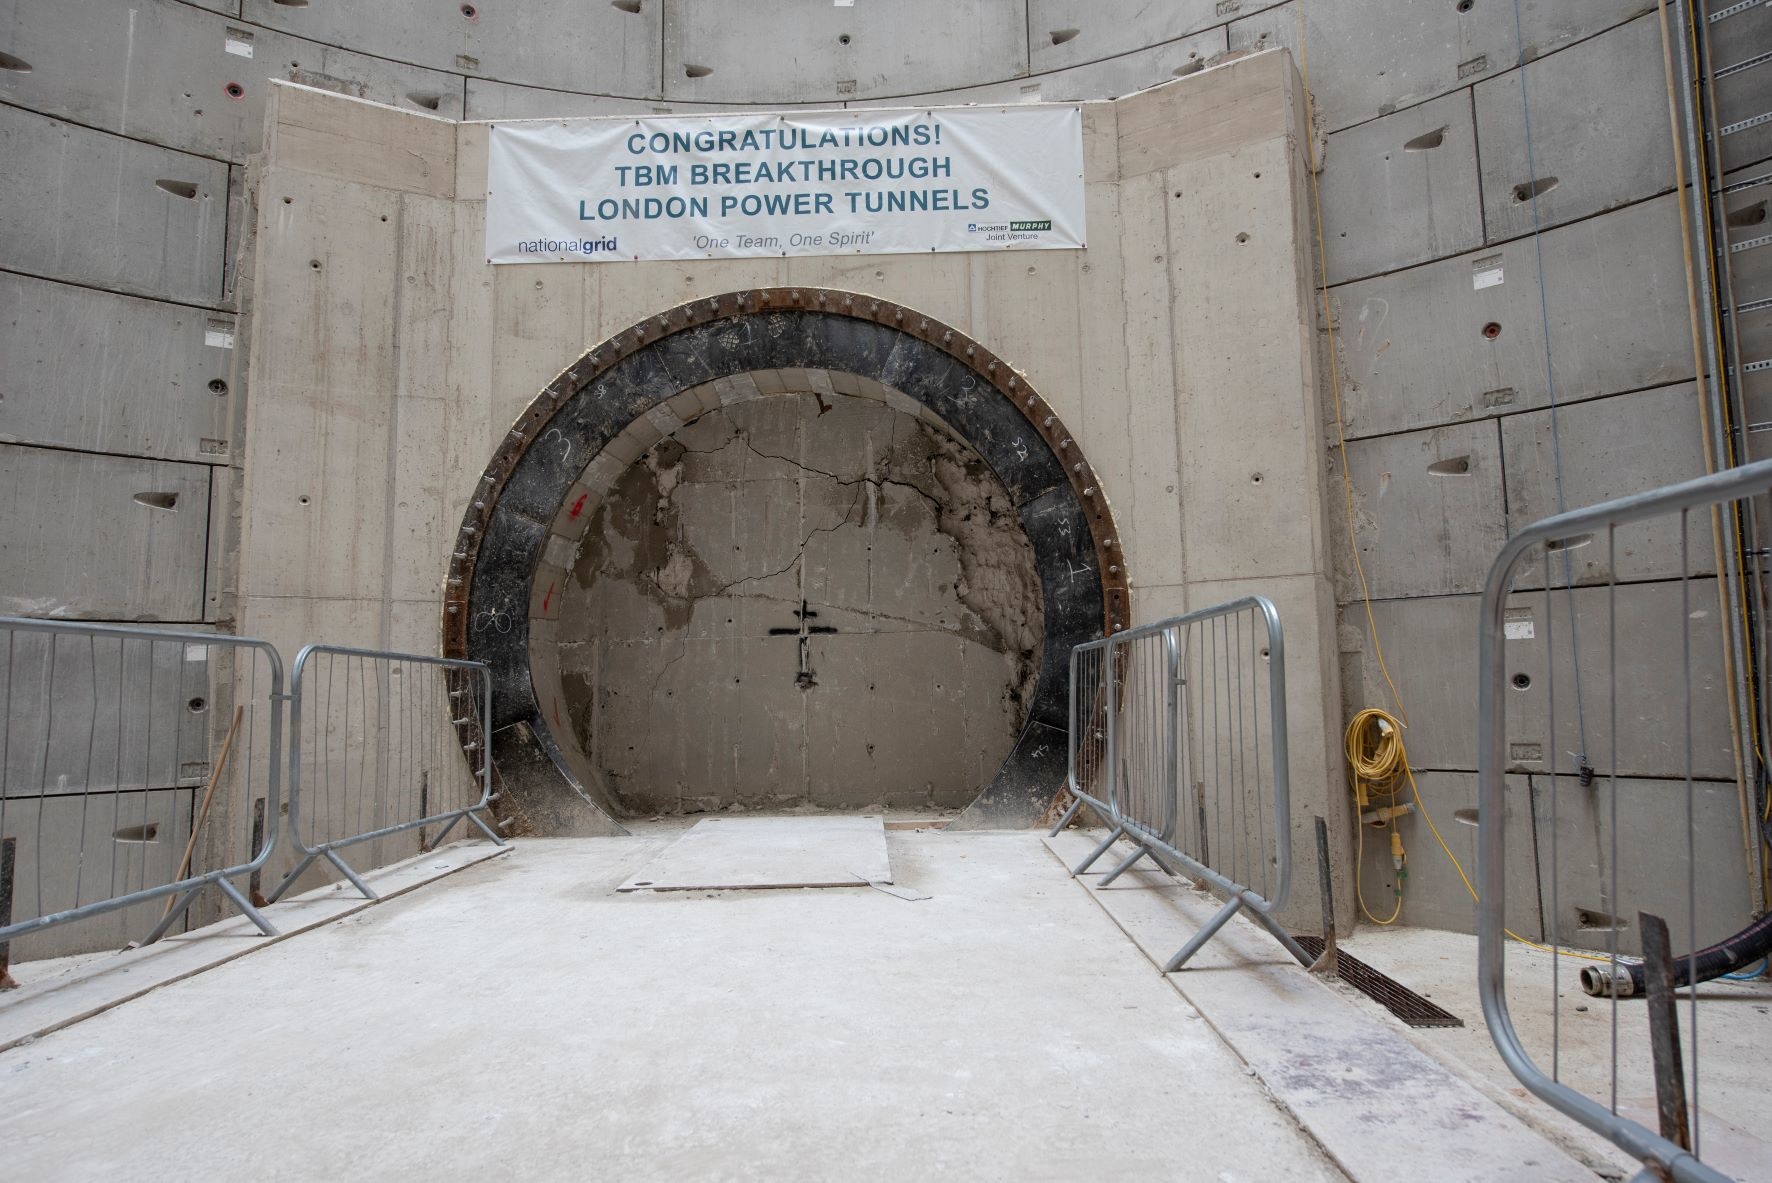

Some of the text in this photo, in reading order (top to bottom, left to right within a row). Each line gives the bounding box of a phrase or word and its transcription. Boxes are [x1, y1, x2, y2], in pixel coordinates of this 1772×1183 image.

[627, 124, 941, 154] CONGRATULATIONS!
[614, 157, 951, 187] TBM BREAKTHROUGH
[579, 188, 990, 221] LONDON POWER TUNNELS
[1011, 222, 1051, 230] MURPHY
[518, 235, 617, 255] nationalgrid
[693, 231, 875, 250] 'One Team, One Spirit'
[986, 232, 1039, 241] Joint Venture
